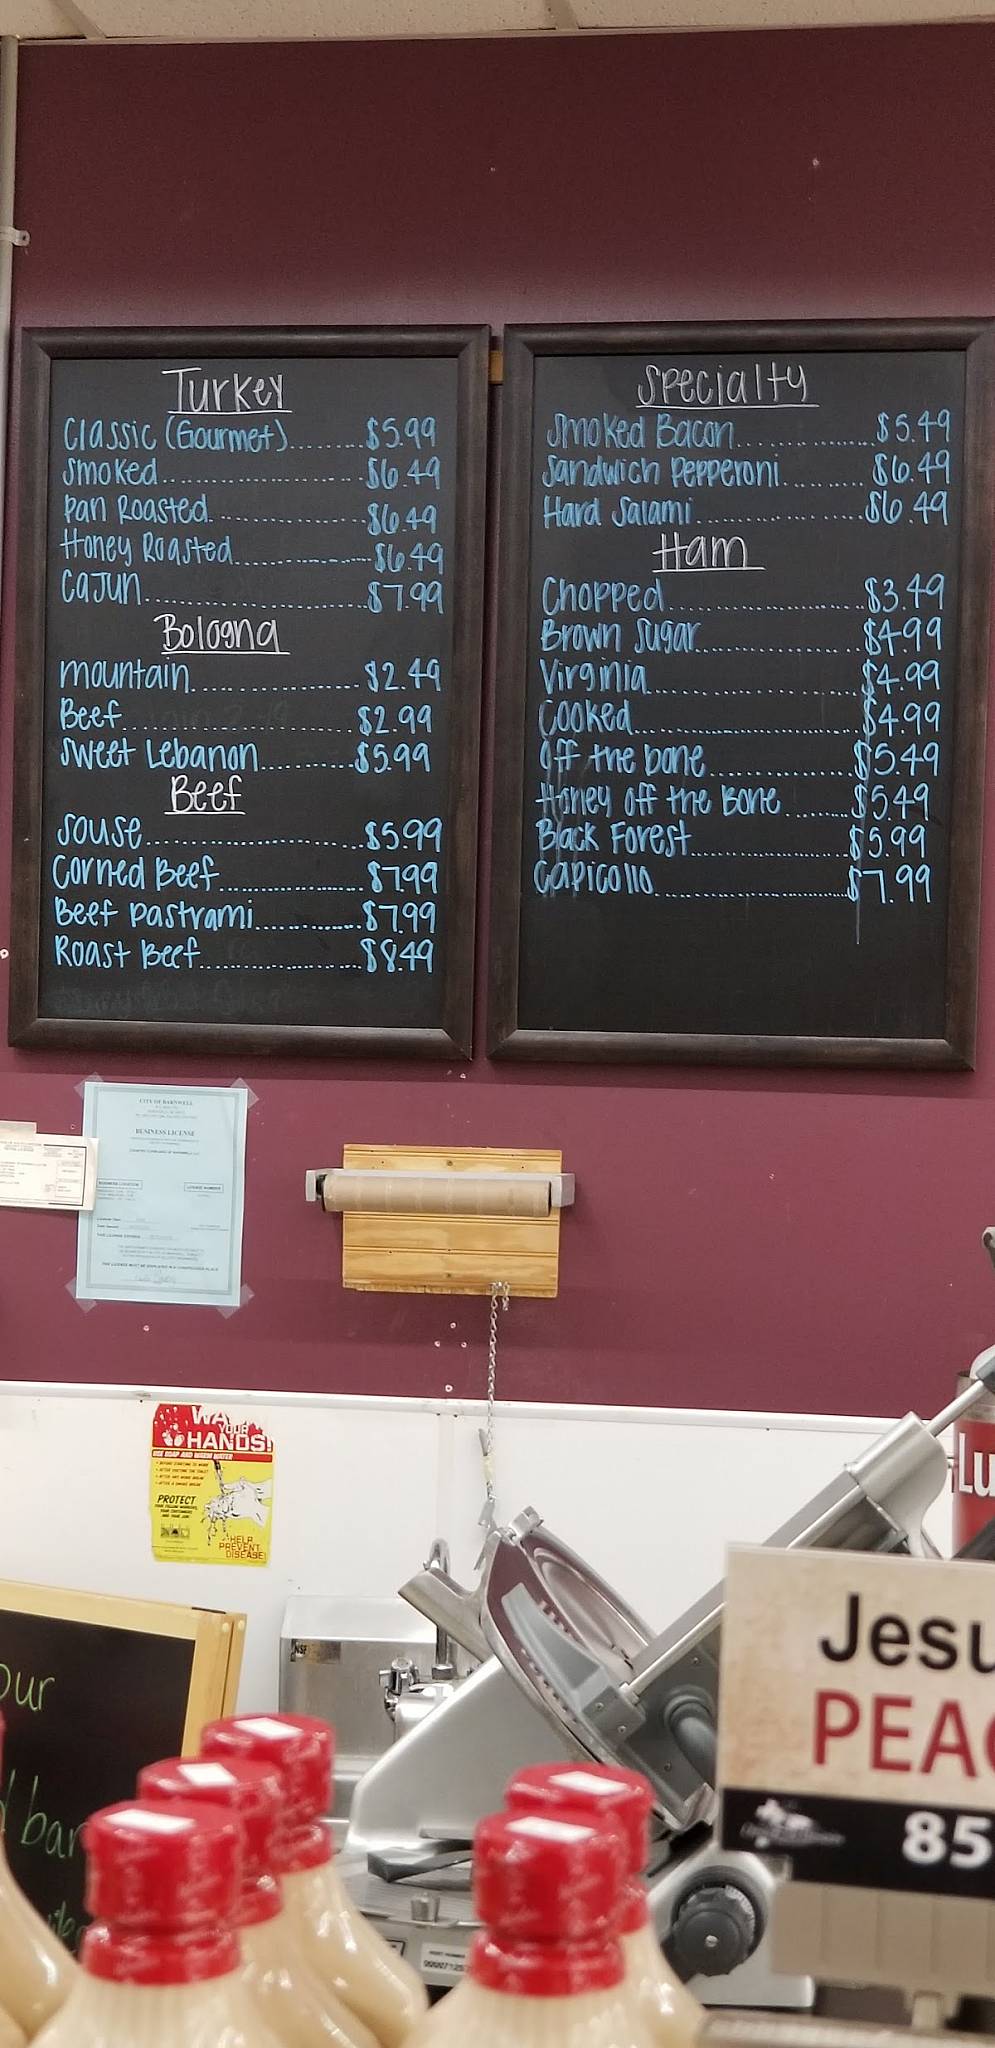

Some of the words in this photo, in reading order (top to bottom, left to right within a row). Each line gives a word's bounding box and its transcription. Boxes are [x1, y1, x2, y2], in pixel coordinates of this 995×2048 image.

[162, 368, 284, 410] Turkey
[64, 417, 157, 451] Classic
[166, 419, 289, 453] (Gourmet)
[366, 417, 436, 450] $5.99
[656, 413, 735, 449] Bacon
[876, 409, 950, 443] $5.49
[366, 457, 441, 490] $6.49
[873, 449, 950, 485] $6.49
[118, 494, 209, 524] Roasted
[366, 504, 437, 535] $6.49
[543, 496, 602, 528] Hard
[865, 490, 949, 526] $6.49
[60, 528, 132, 566] Honey
[143, 531, 233, 565] Roasted
[375, 543, 443, 574] $6.49
[652, 532, 747, 568] Ham
[366, 581, 444, 613] $7.99
[542, 577, 664, 613] Chopped
[864, 573, 945, 613] $3.49
[154, 613, 280, 652] Bologna
[541, 617, 621, 652] Brown
[862, 616, 942, 656] $4.99
[365, 658, 441, 692] $2.49
[539, 657, 648, 695] Virginia
[861, 659, 940, 697] $4.99
[60, 698, 122, 730] Beef
[358, 705, 432, 736] $2.99
[539, 700, 632, 736] Cooked
[862, 701, 941, 736] $4.99
[146, 738, 259, 772] Lebanon
[354, 742, 431, 773] $5.99
[589, 744, 636, 774] the
[854, 739, 939, 776] $5.49
[171, 775, 243, 812] Beef
[536, 783, 612, 818] Honey
[666, 785, 711, 817] the
[851, 782, 929, 821] $5.49
[364, 817, 442, 852] $5.99
[612, 820, 693, 857] Forest
[848, 825, 926, 859] $5.99
[53, 855, 145, 890] Corned
[156, 855, 219, 891] Beef
[368, 861, 438, 894] $7.99
[847, 864, 931, 903] $7.99
[55, 897, 118, 928] Beef
[362, 901, 436, 933] $7.99
[55, 935, 131, 969] Roast
[142, 936, 201, 970] Beef
[361, 939, 433, 973] $8.49
[187, 1431, 273, 1452] HANDS!
[218, 1423, 249, 1435] YOUR
[157, 1494, 197, 1505] PROTECT
[219, 1542, 261, 1552] PREVENT
[230, 1535, 254, 1544] HELP
[812, 1688, 995, 1780] PEA
[902, 1810, 993, 1870] 85
